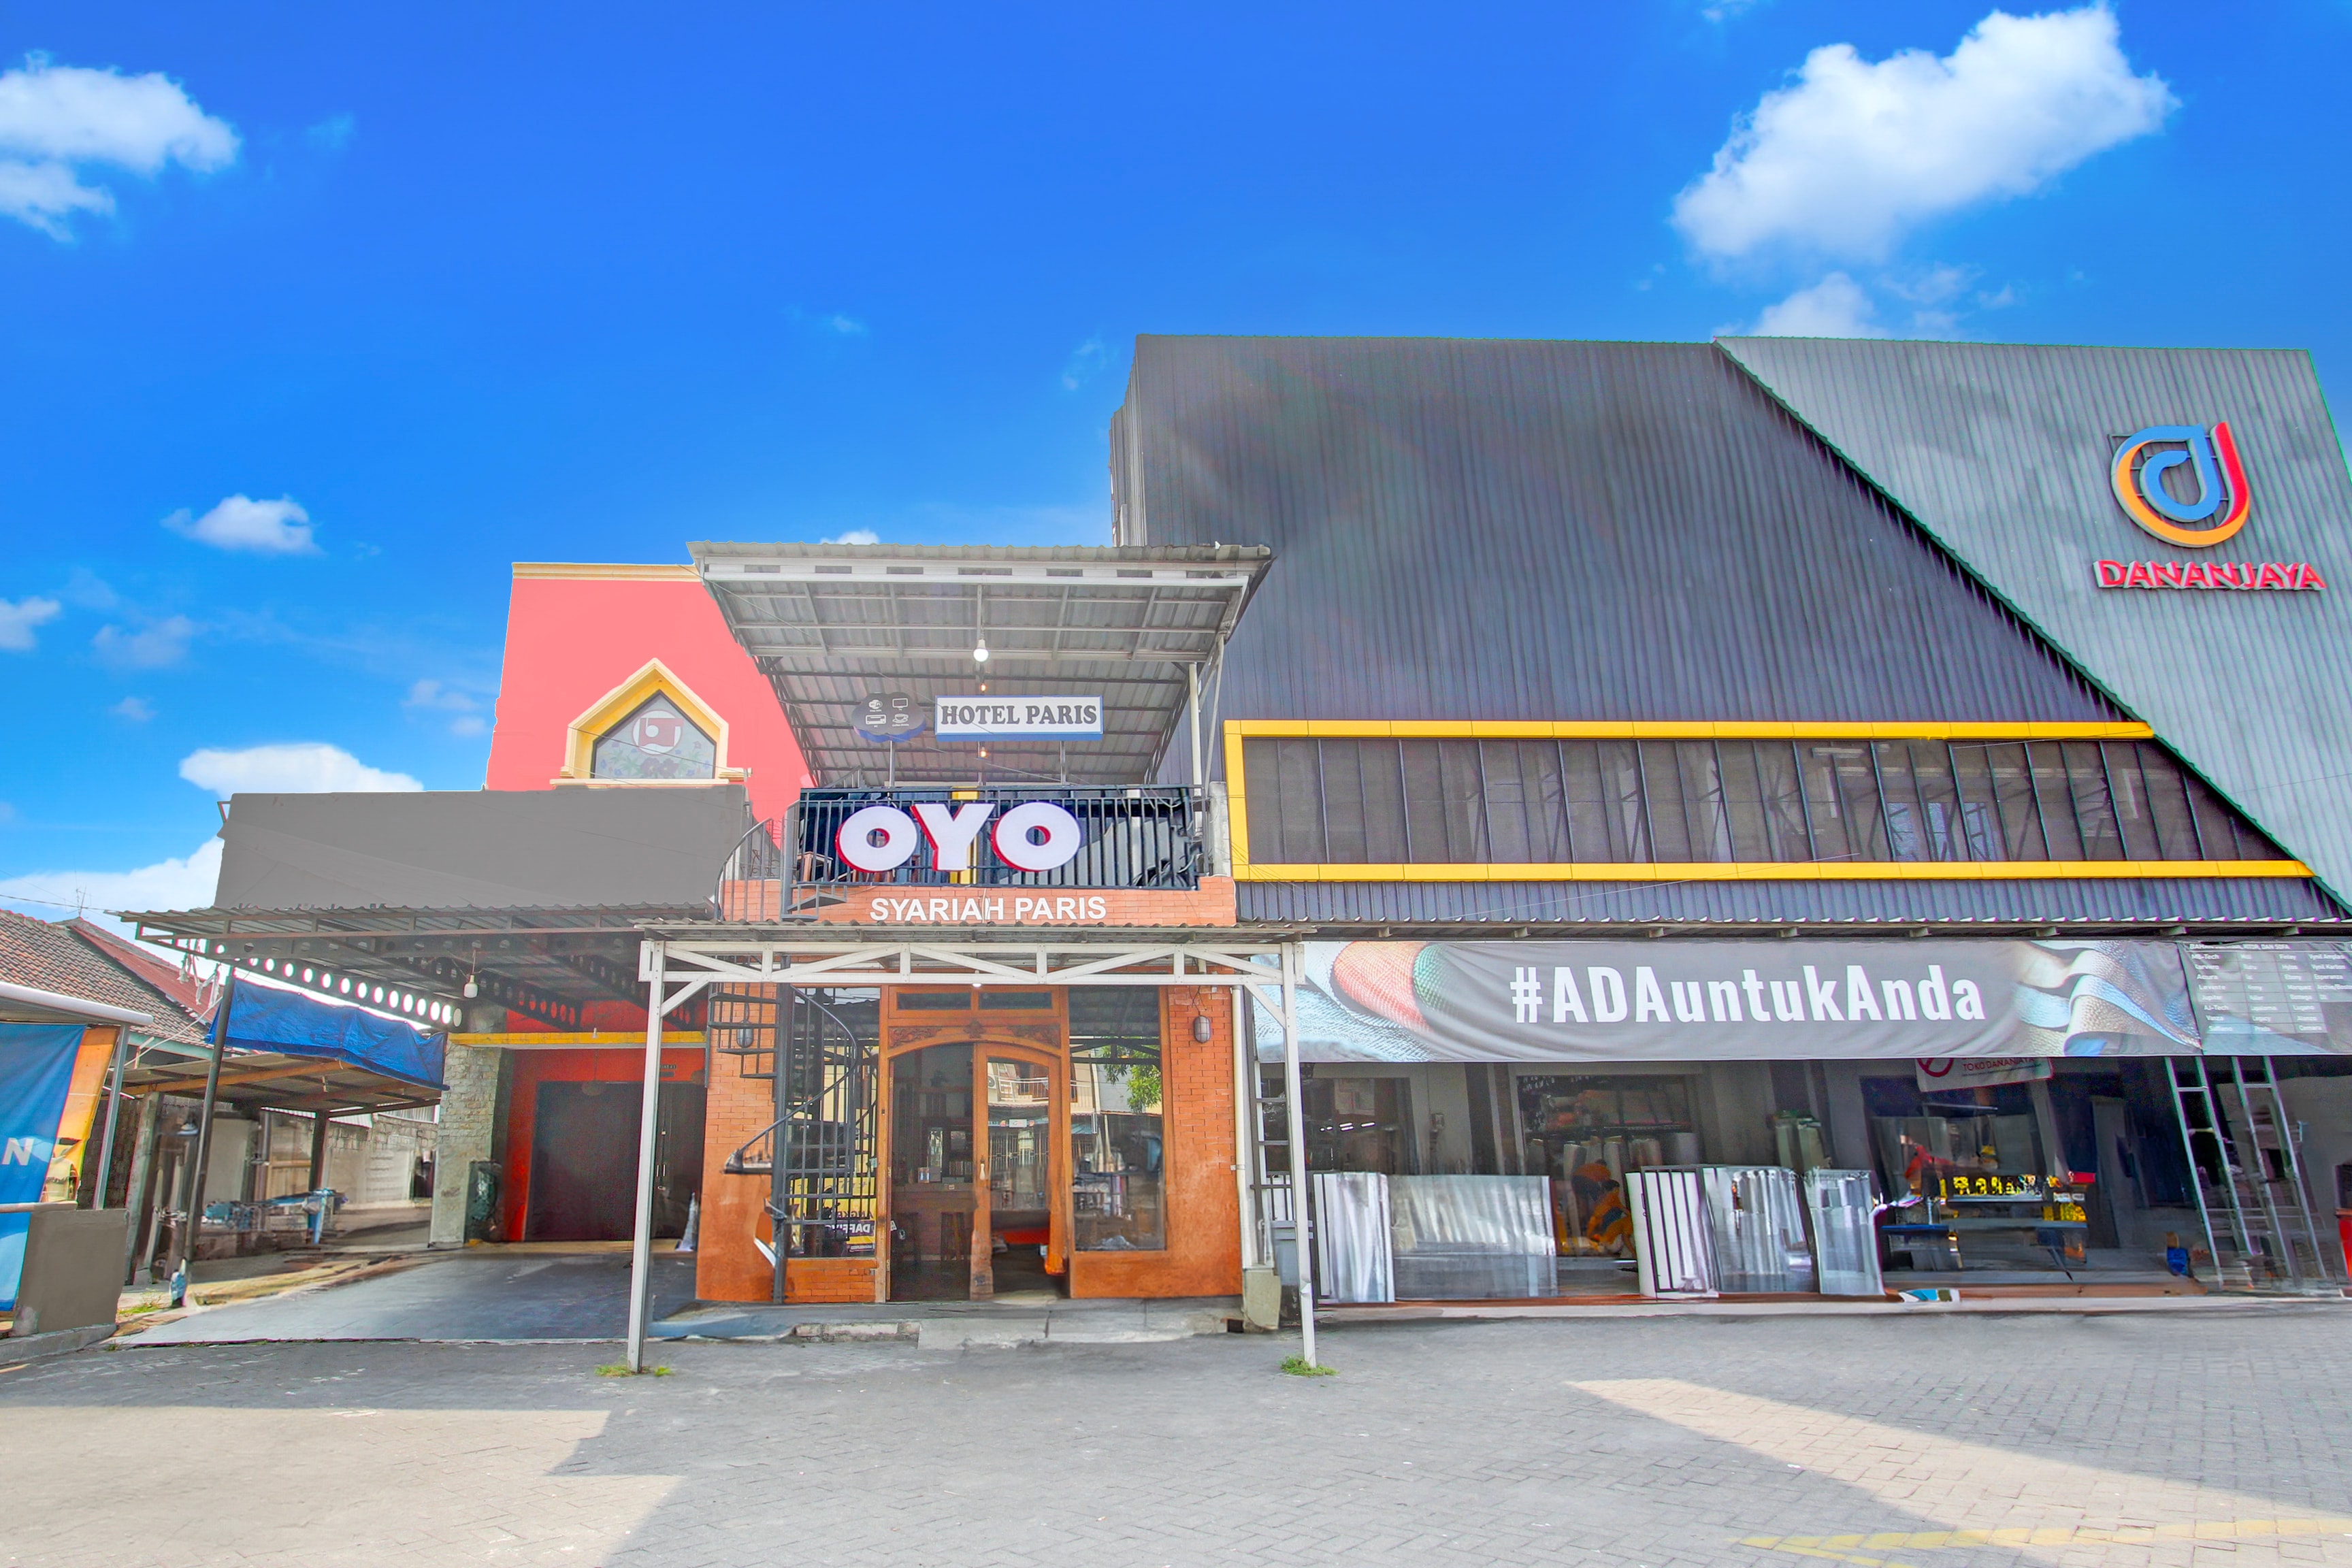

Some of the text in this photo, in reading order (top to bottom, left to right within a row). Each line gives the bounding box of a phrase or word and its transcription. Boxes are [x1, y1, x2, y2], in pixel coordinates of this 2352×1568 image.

[2093, 559, 2327, 590] DANANJAYA
[941, 704, 1097, 726] HOTEL PARIS
[834, 802, 1081, 872] OYO
[870, 896, 1107, 922] SYARIAH PARIS
[1509, 964, 1986, 1024] #ADAuntukAnda
[1962, 1062, 1986, 1072] TOKO
